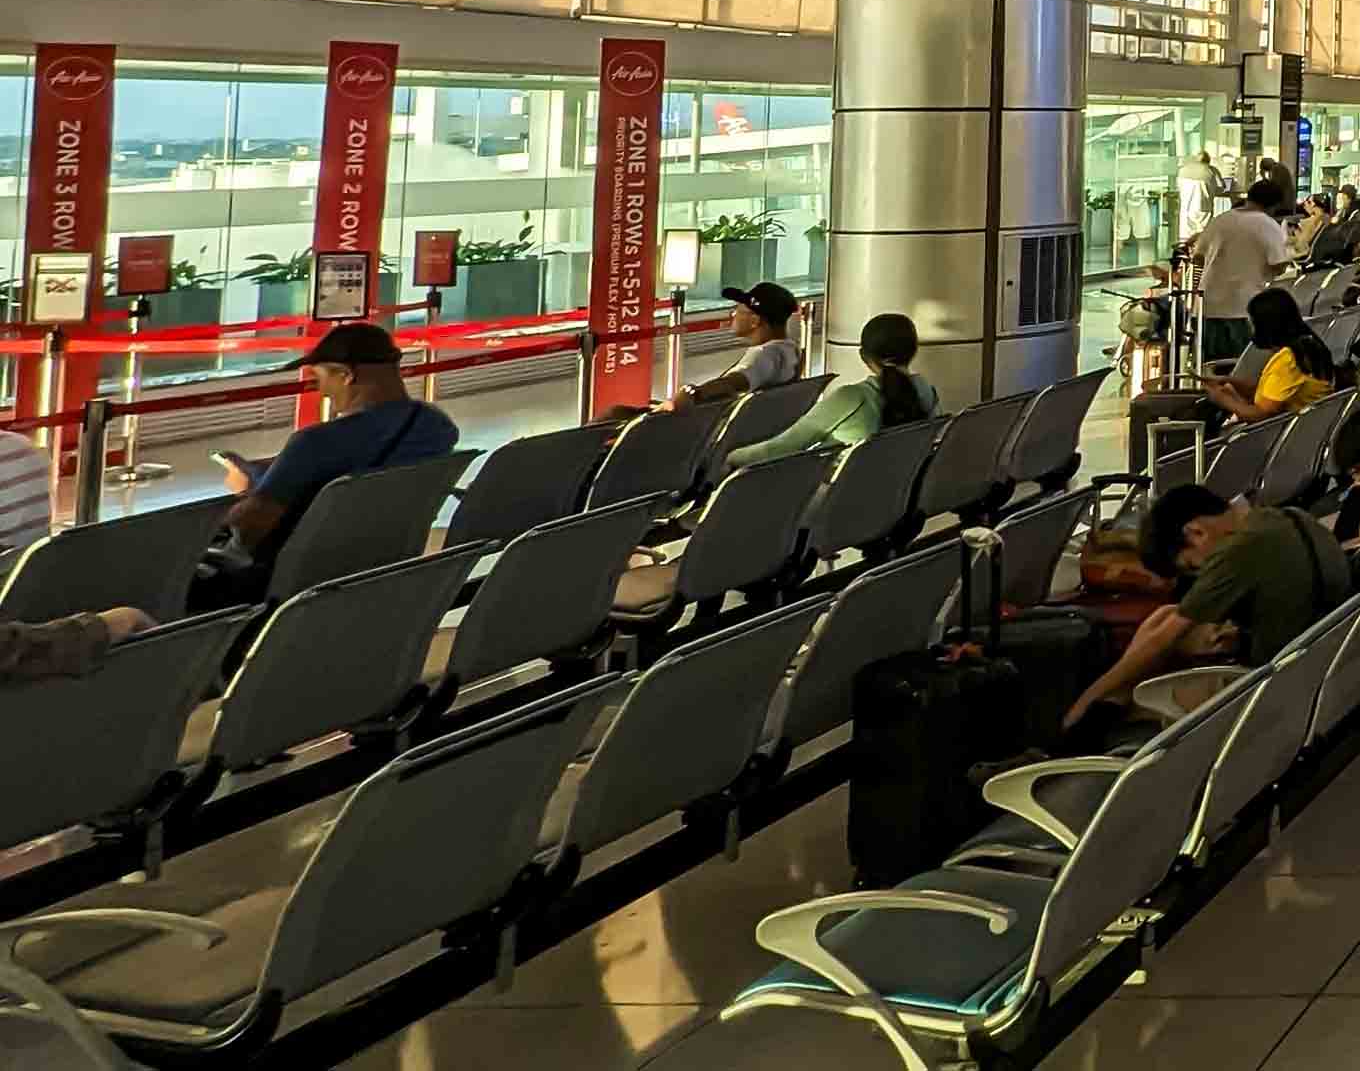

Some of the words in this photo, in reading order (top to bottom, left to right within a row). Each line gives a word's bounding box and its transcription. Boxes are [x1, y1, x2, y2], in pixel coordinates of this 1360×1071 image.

[55, 119, 81, 177] ZONE
[344, 119, 368, 177] ZONE
[627, 116, 647, 175] ZONE
[54, 183, 78, 197] 3
[342, 183, 363, 195] 2
[620, 342, 639, 366] 14
